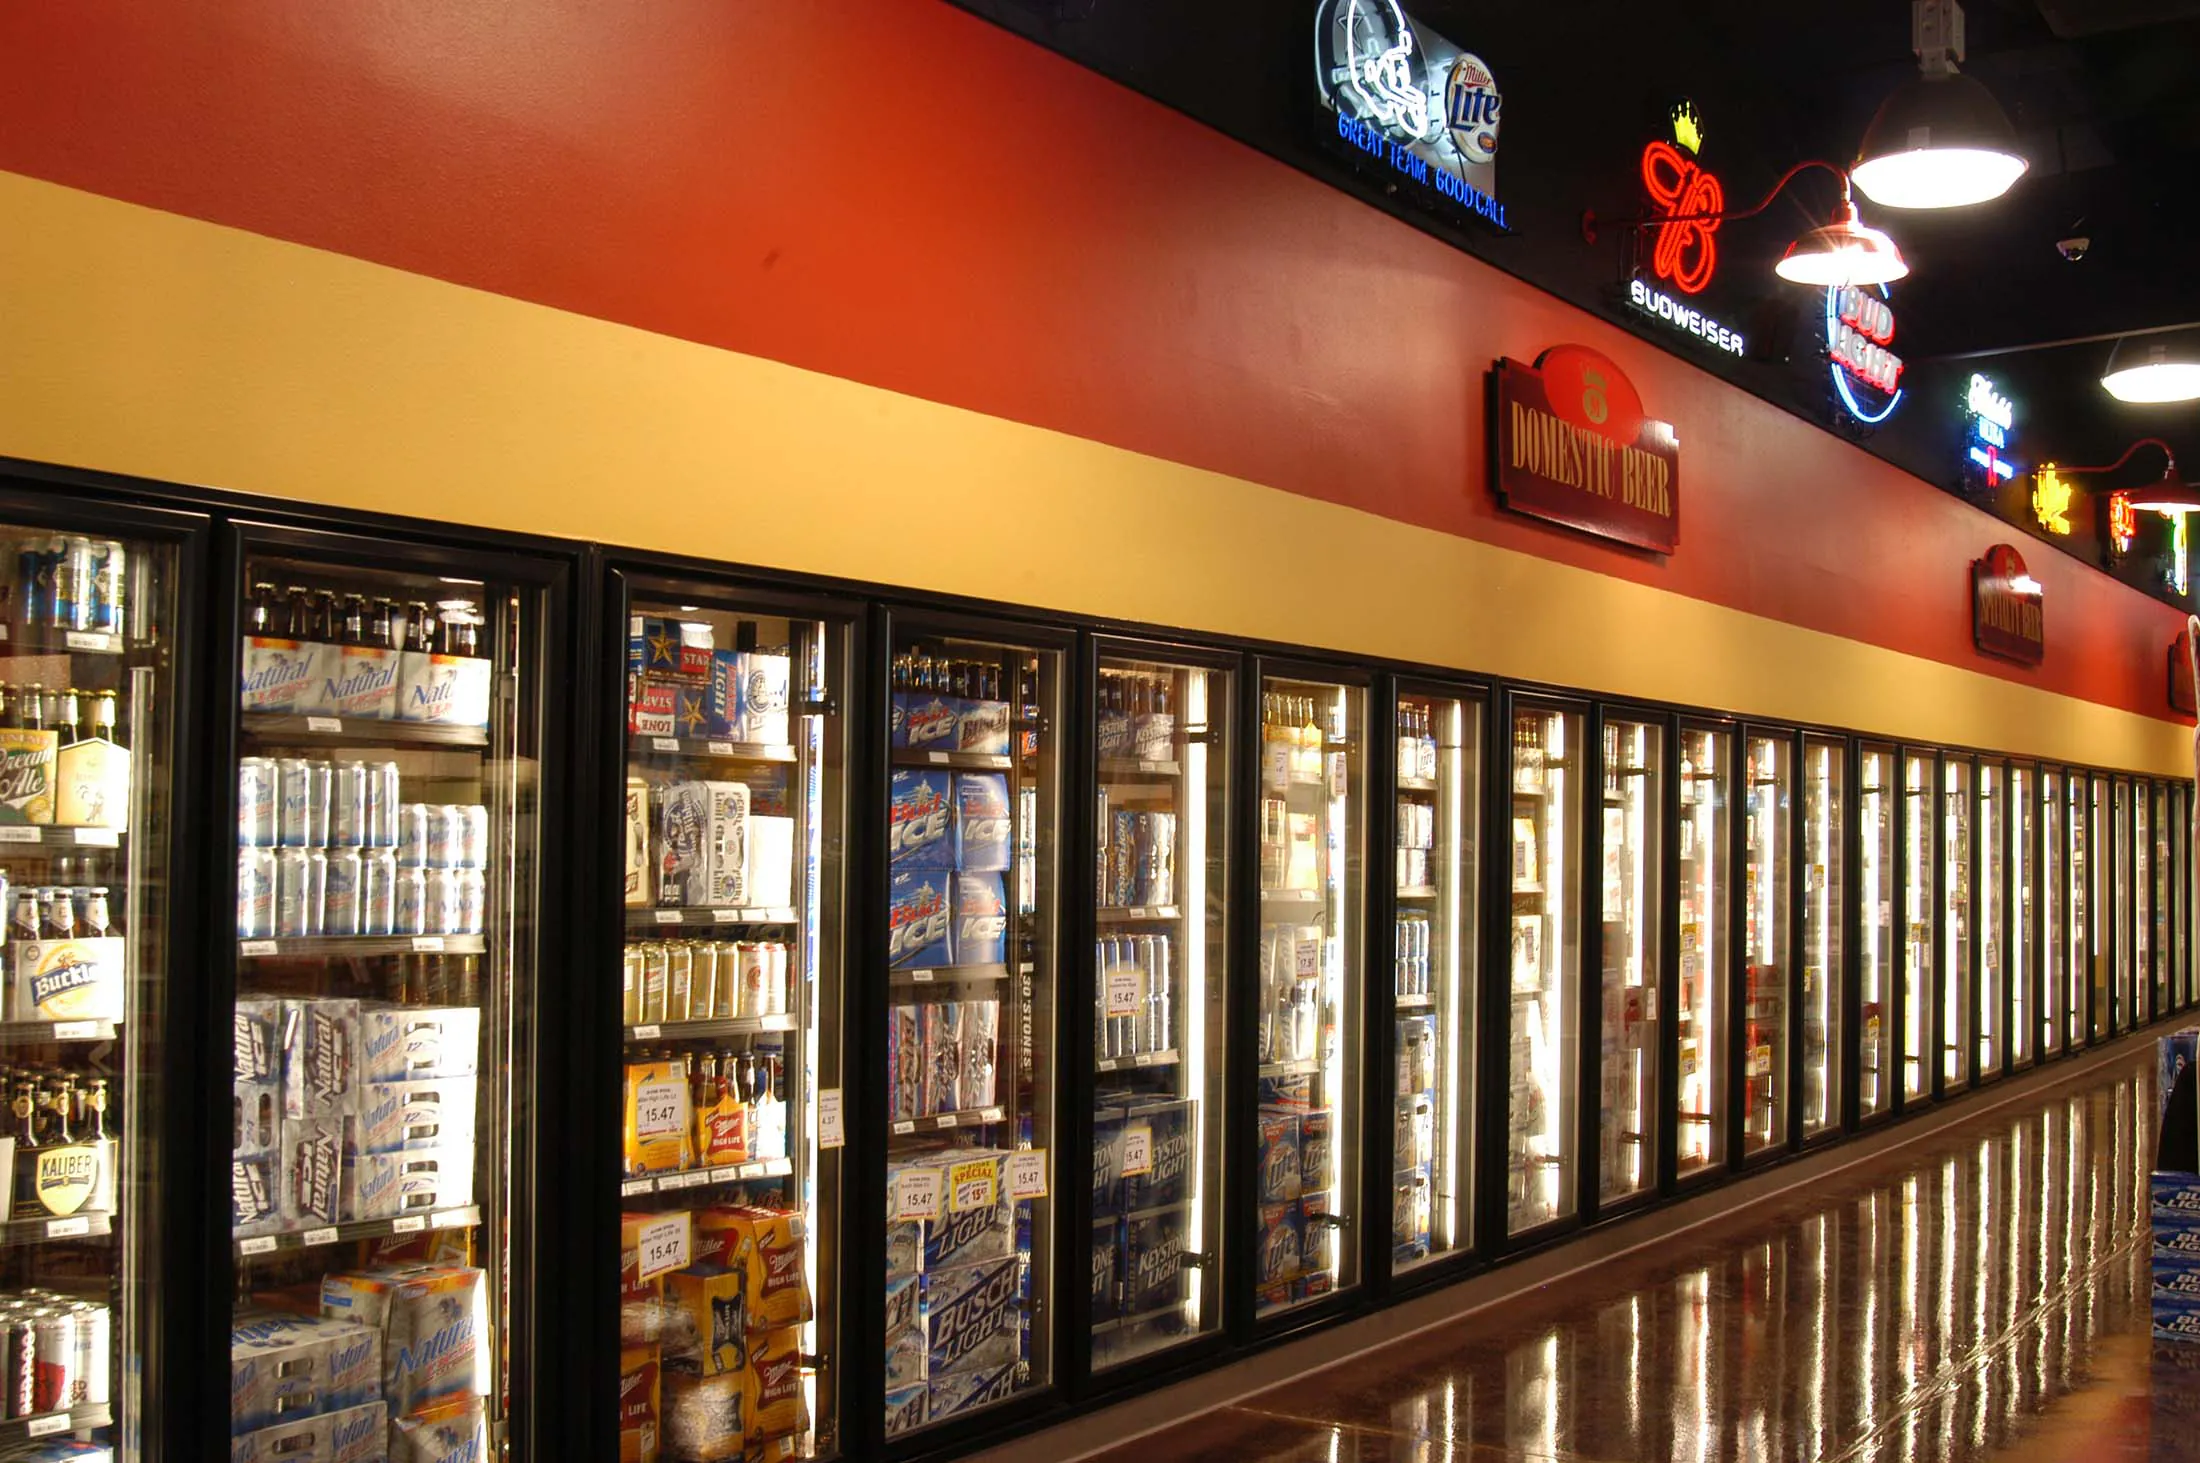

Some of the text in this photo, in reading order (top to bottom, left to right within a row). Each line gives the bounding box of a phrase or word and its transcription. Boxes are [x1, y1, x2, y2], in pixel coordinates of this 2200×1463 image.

[1463, 63, 1491, 87] Miller
[1450, 84, 1502, 133] Lite
[1338, 111, 1384, 158] GREAT
[1436, 167, 1474, 208] GOOD
[1630, 279, 1744, 357] BUDWEISER
[1841, 284, 1896, 346] BUD
[1830, 323, 1904, 395] LIGHT
[1511, 400, 1671, 518] DOMESTIC BEER
[319, 660, 398, 705] Natural
[714, 658, 727, 719] LIGHT
[642, 719, 672, 733] LONE
[909, 715, 955, 746] ICE
[890, 807, 949, 852] ICE
[965, 818, 1011, 841] ICE
[889, 911, 948, 956] ICE
[961, 917, 1006, 939] ICE
[1114, 992, 1134, 1004] 15.47
[250, 1021, 269, 1075] ICE
[313, 1010, 332, 1107] Natural
[332, 1029, 344, 1094] ICE
[646, 1106, 676, 1122] 15.47
[727, 1135, 741, 1145] LIFE
[41, 1154, 92, 1178] KALIBER
[246, 1163, 269, 1211] ICE
[302, 1142, 313, 1209] ICE
[312, 1126, 334, 1222] Natural
[954, 1168, 993, 1185] SPECIAL
[1018, 1171, 1038, 1185] 15.47
[1150, 1152, 1187, 1184] LIGHT
[1271, 1150, 1298, 1192] Lite
[907, 1193, 933, 1206] 15.47
[650, 1239, 680, 1263] 15.47
[1147, 1253, 1184, 1289] LIGHT
[933, 1264, 1016, 1350] BUSCH
[943, 1304, 1005, 1365] LIGHT
[628, 1402, 647, 1416] LIFE
[782, 1382, 797, 1395] LIFE
